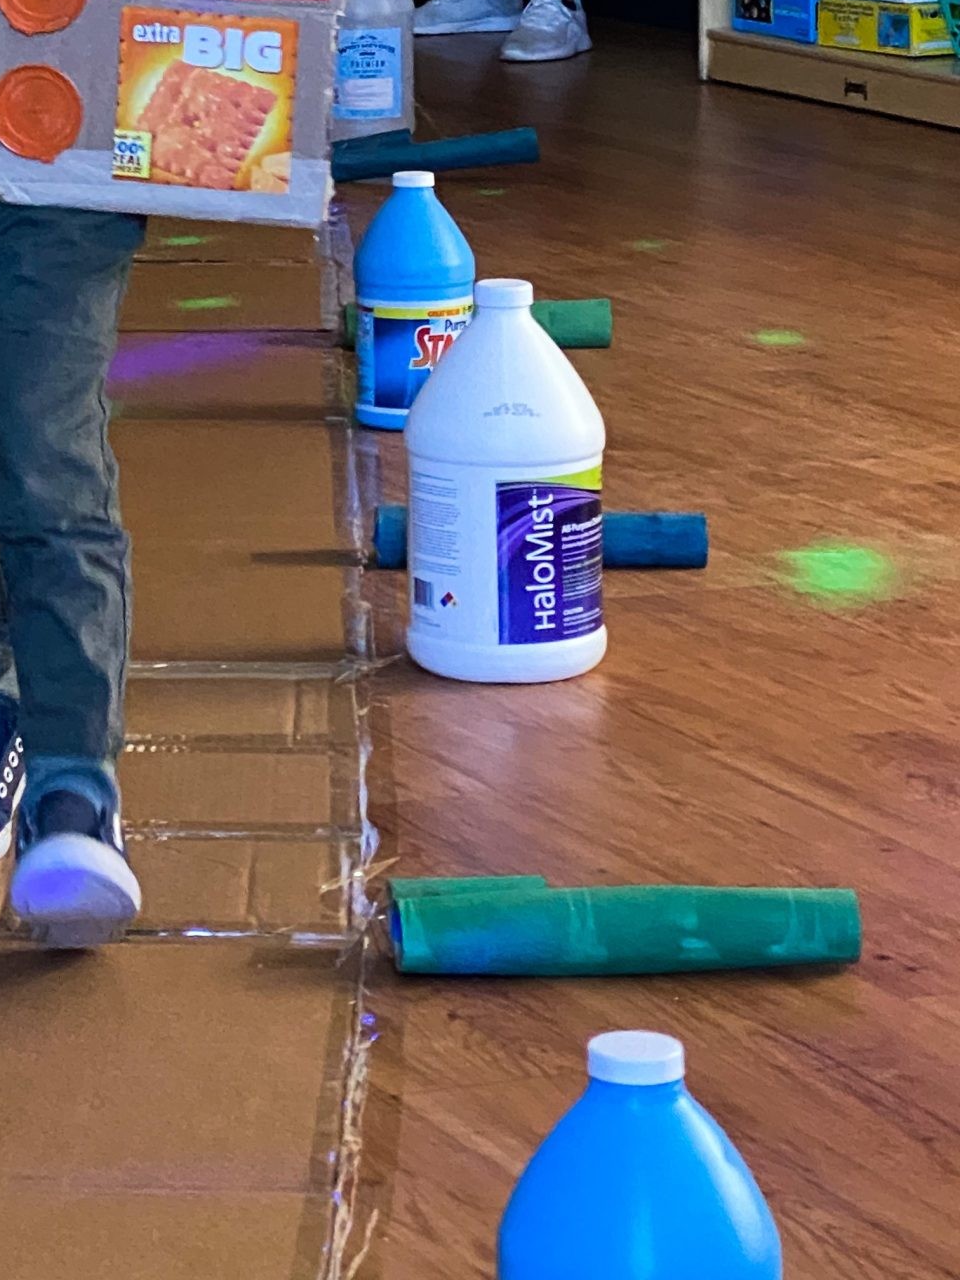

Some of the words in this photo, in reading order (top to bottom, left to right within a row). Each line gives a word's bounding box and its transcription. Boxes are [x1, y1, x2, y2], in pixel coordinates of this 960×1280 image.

[133, 22, 181, 44] extra
[181, 24, 283, 74] BIG
[524, 493, 557, 630] HaloMist
